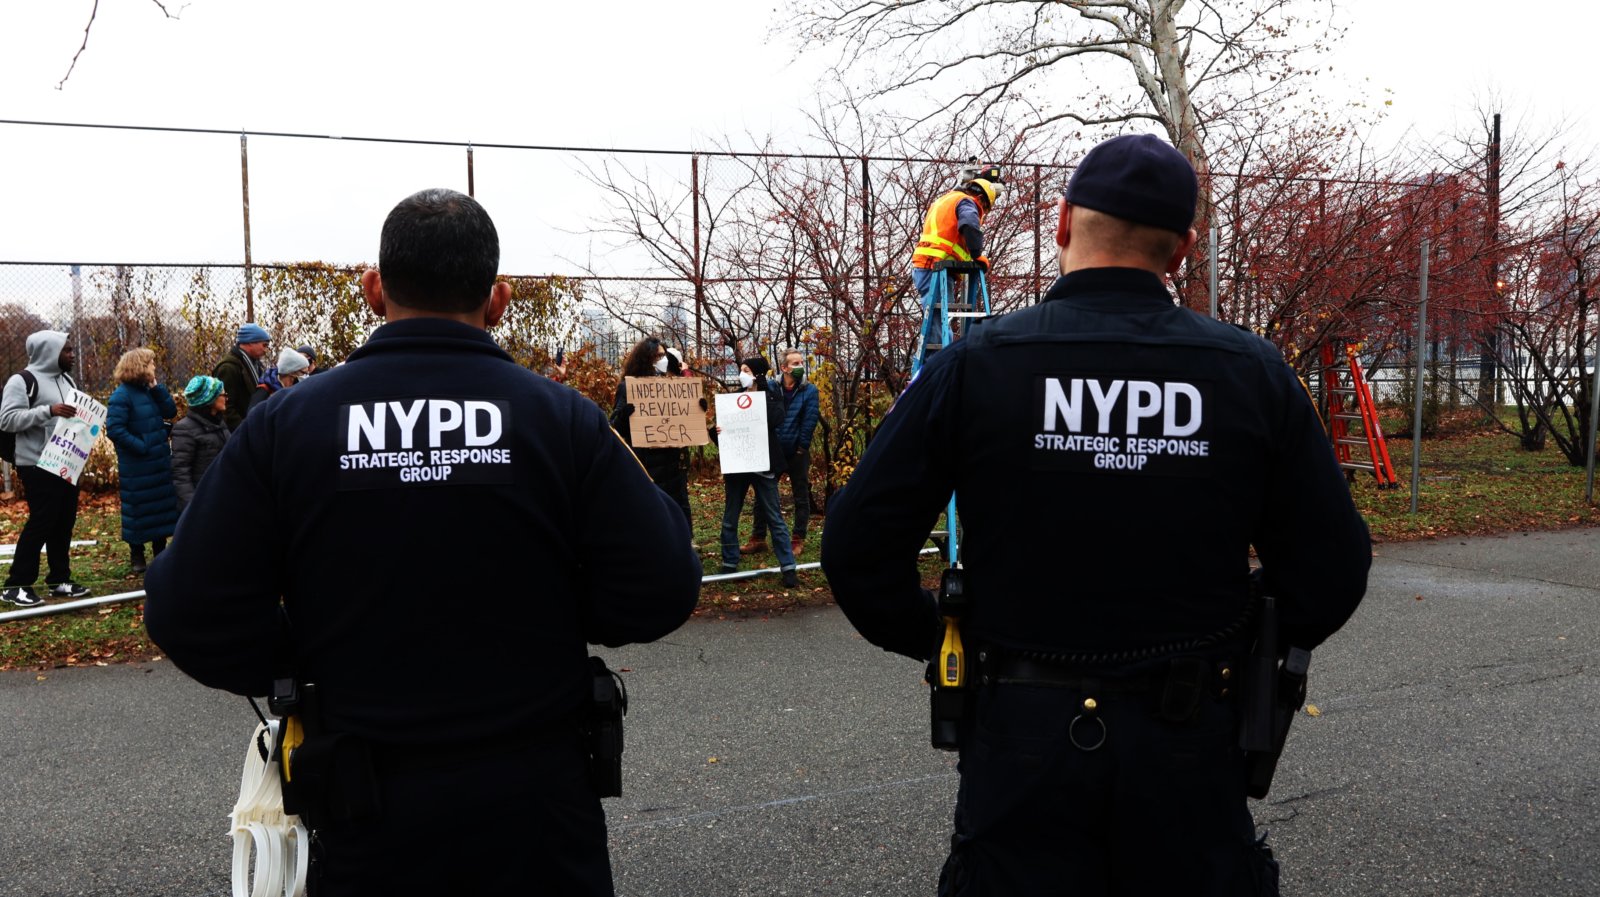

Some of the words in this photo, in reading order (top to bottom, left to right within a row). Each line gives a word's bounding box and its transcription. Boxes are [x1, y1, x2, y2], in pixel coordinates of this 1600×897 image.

[631, 382, 700, 400] INDEPENDENT
[639, 401, 690, 417] REVIEW
[1043, 377, 1203, 437] NYPD
[347, 399, 503, 452] NYPD
[644, 424, 692, 443] ESCR
[1034, 433, 1120, 453] STRATEGIC
[1126, 437, 1209, 457] RESPONSE
[339, 451, 424, 470] STRATEGIC
[430, 449, 511, 466] RESPONSE
[1093, 453, 1148, 471] GROUP
[399, 465, 452, 483] GROUP
